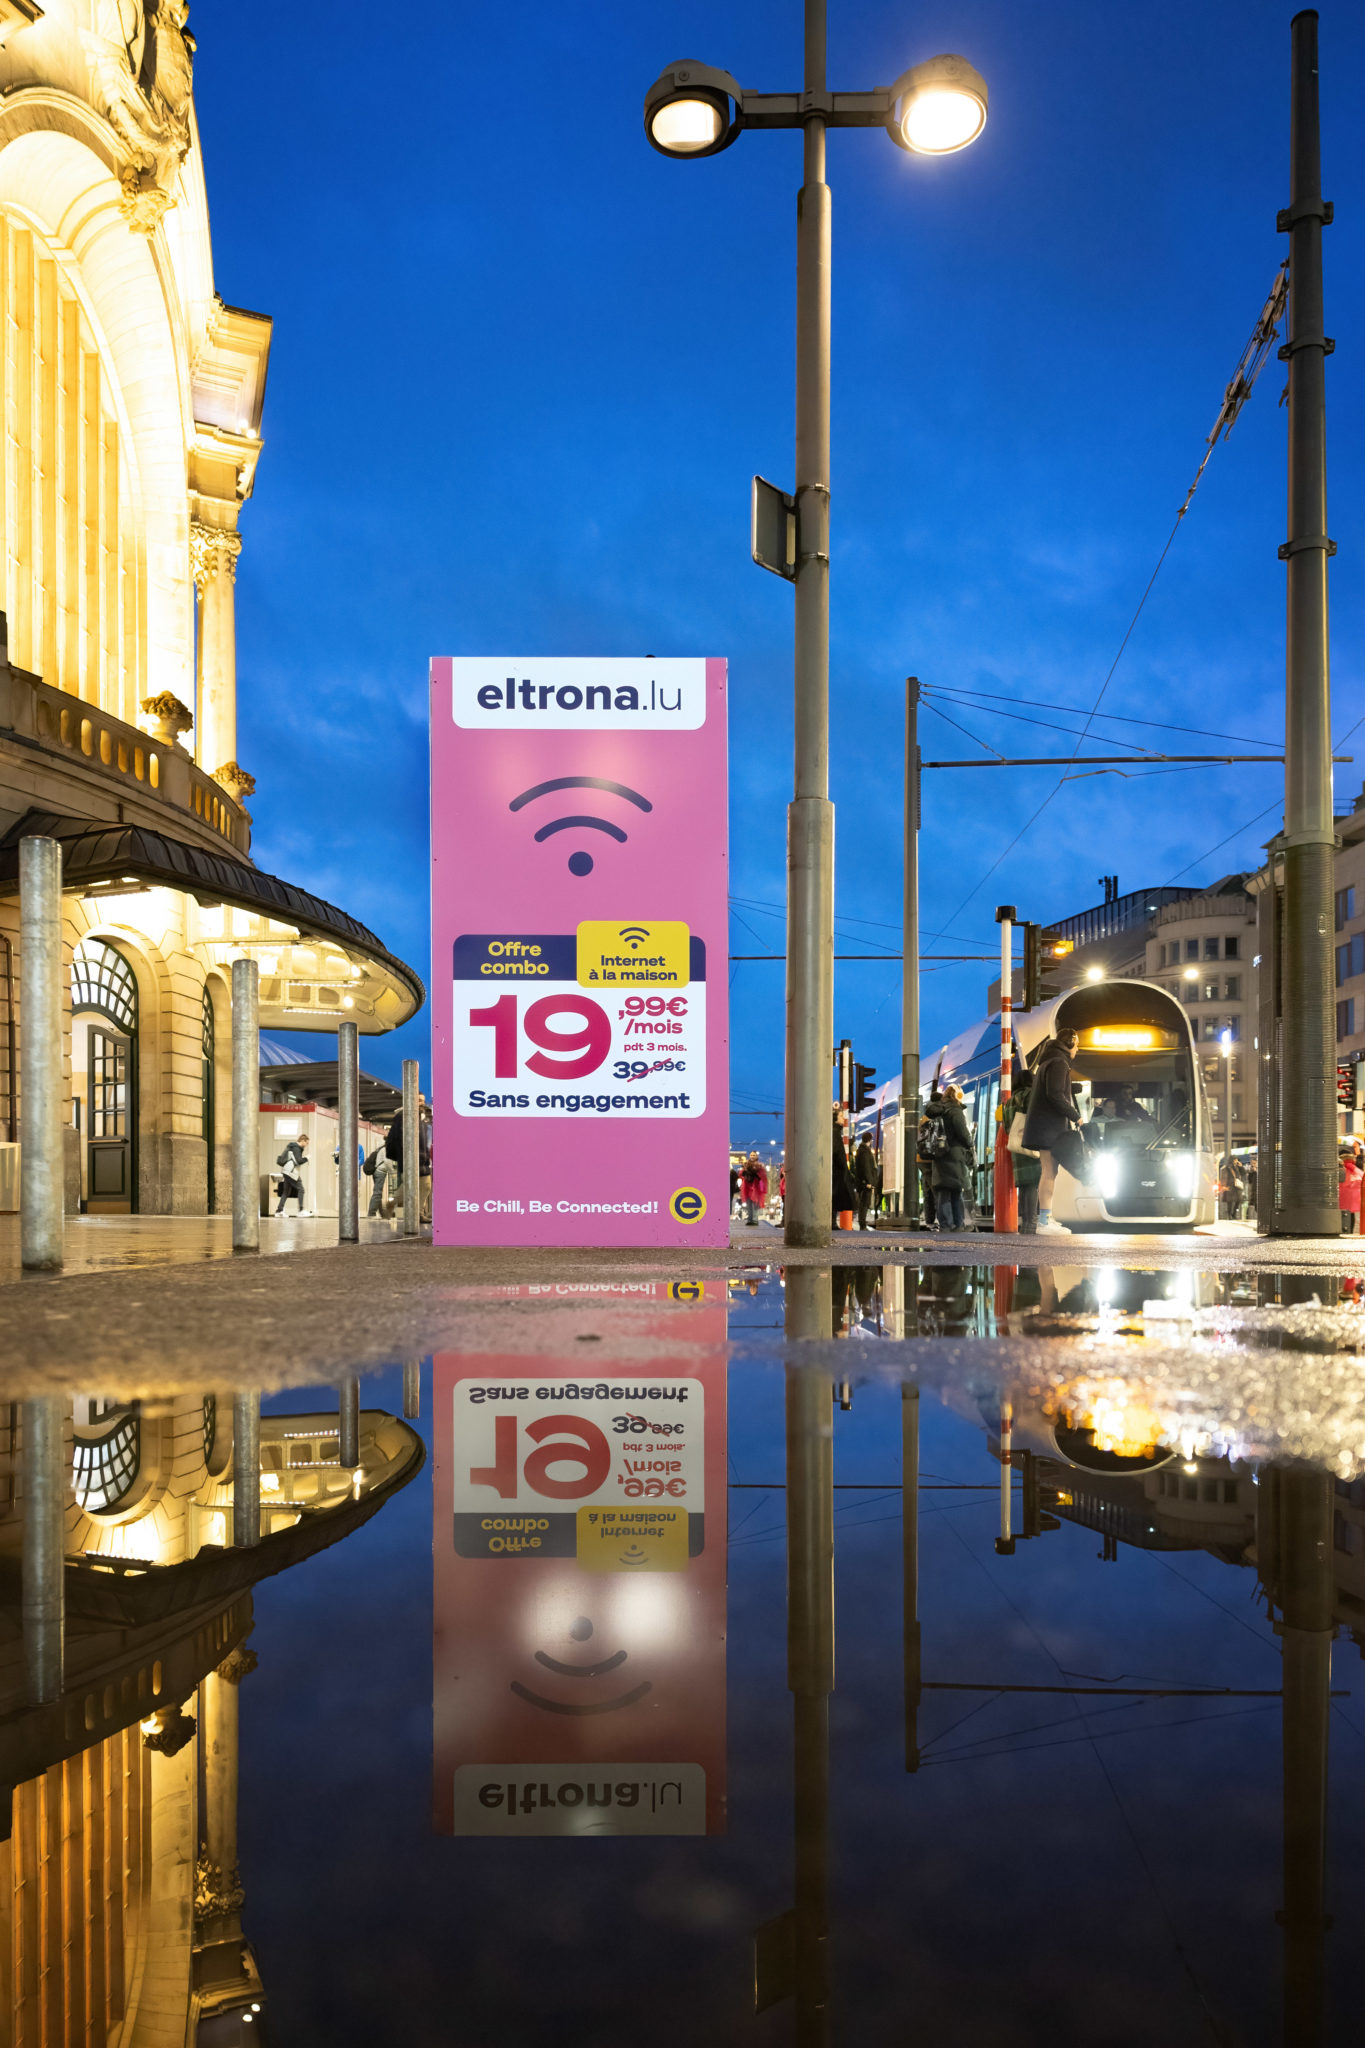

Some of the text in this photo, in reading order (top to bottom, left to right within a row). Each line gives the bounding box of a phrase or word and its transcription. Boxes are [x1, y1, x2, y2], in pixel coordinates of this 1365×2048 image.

[477, 677, 681, 711] eltrona.lu
[488, 941, 541, 957] Offre
[480, 959, 549, 975] combo
[601, 955, 666, 967] Internet
[589, 969, 677, 981] à la maison
[624, 1019, 683, 1036] /mois
[624, 1042, 687, 1053] pdt 3 mois.
[469, 1090, 690, 1112] Sans engagement
[457, 1200, 658, 1214] Be Chill, Be Connected!
